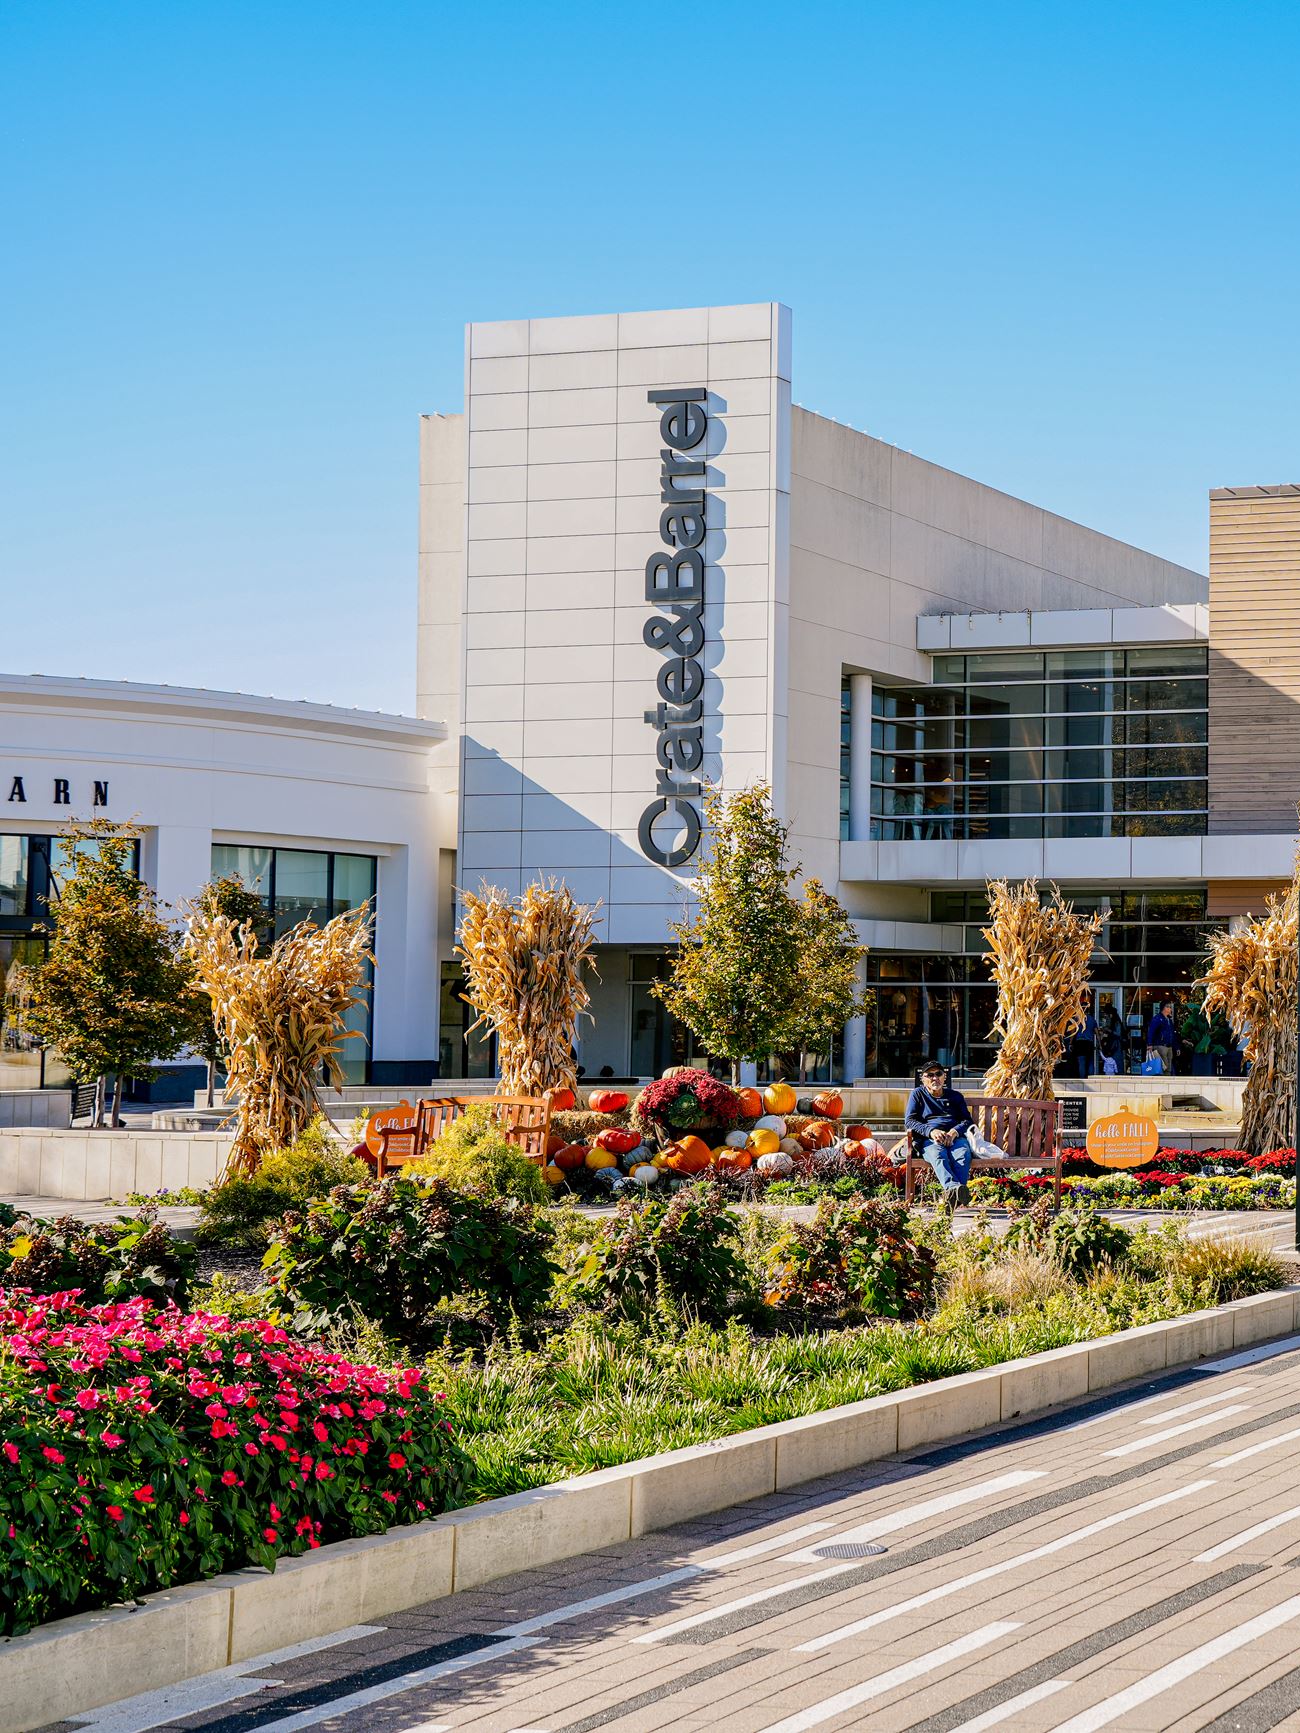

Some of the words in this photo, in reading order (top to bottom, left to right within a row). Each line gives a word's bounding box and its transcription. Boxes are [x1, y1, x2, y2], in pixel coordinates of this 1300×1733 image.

[638, 387, 707, 868] Crate&Barrel
[1095, 1123, 1120, 1138] hello
[1123, 1122, 1149, 1137] FALL!
